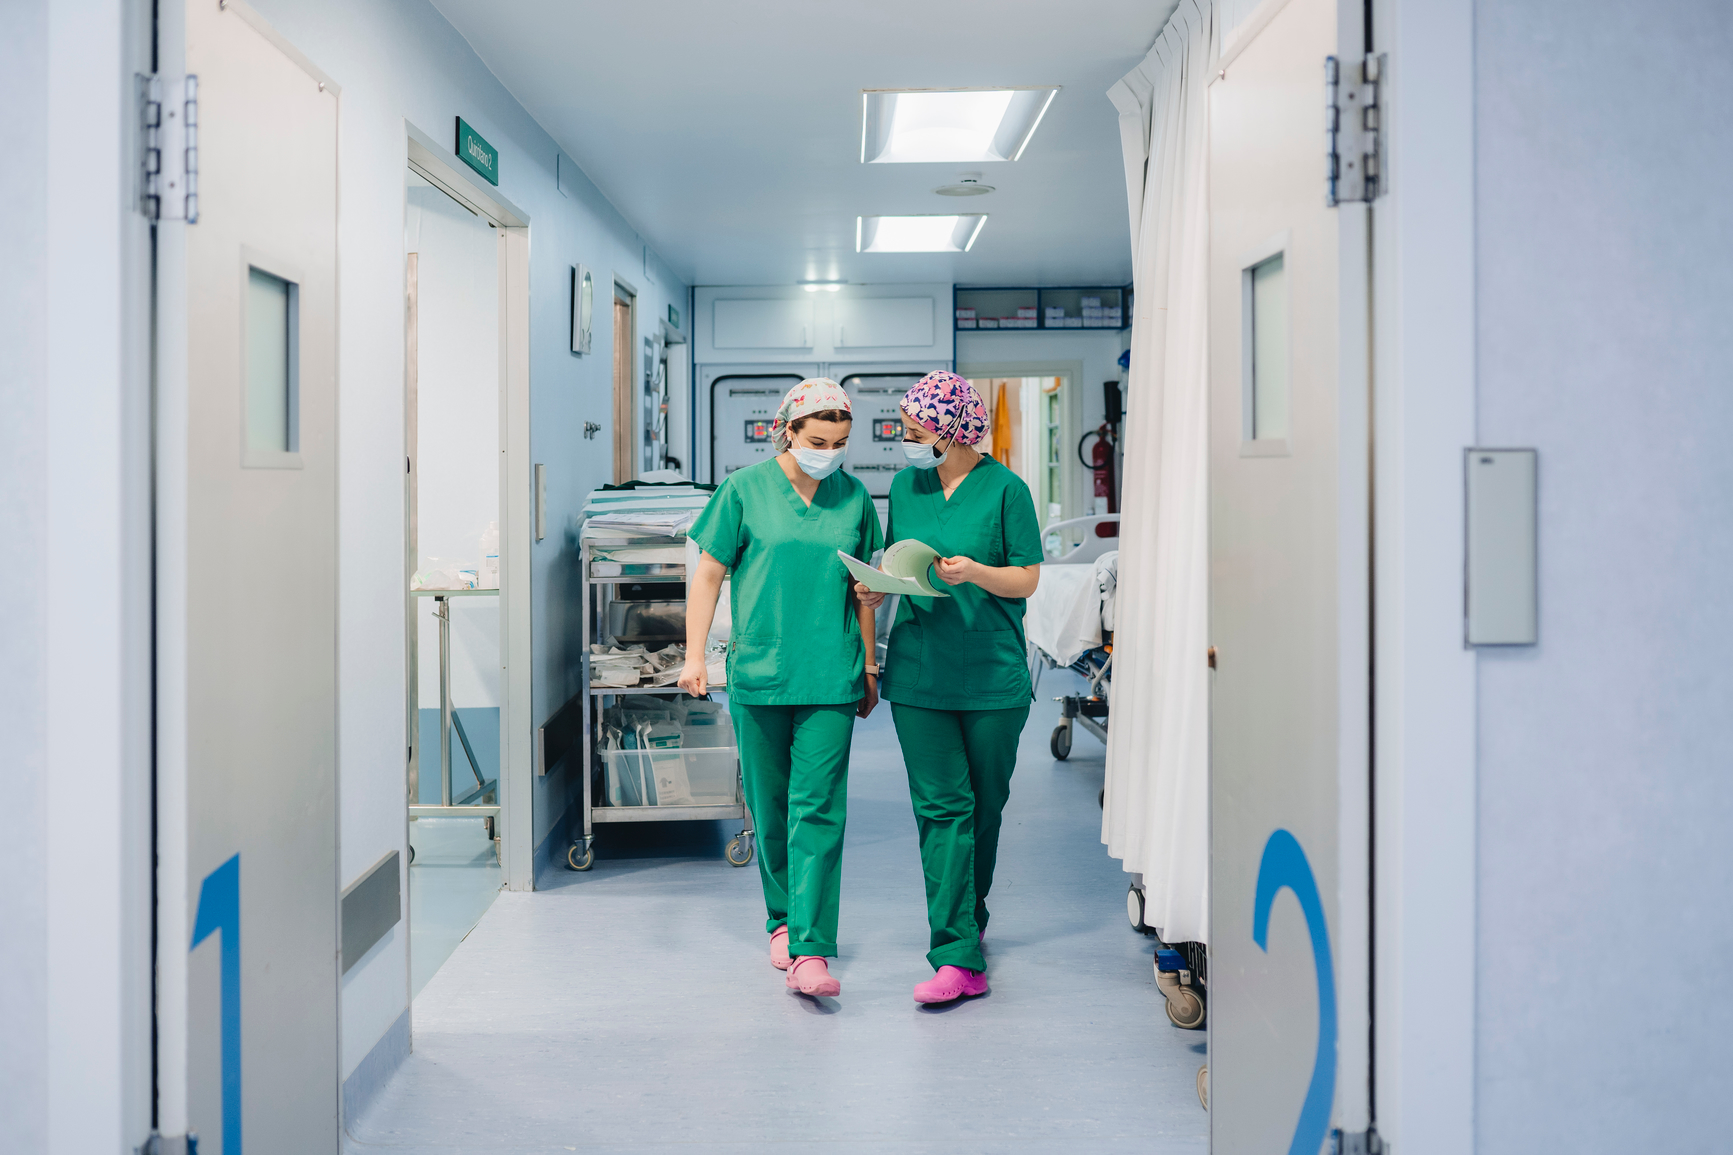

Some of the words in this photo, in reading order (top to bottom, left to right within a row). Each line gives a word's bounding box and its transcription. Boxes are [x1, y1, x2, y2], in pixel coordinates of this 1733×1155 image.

[467, 135, 488, 167] Quirófano
[488, 153, 492, 170] 2
[190, 852, 241, 1155] 1
[1253, 828, 1337, 1155] 2
